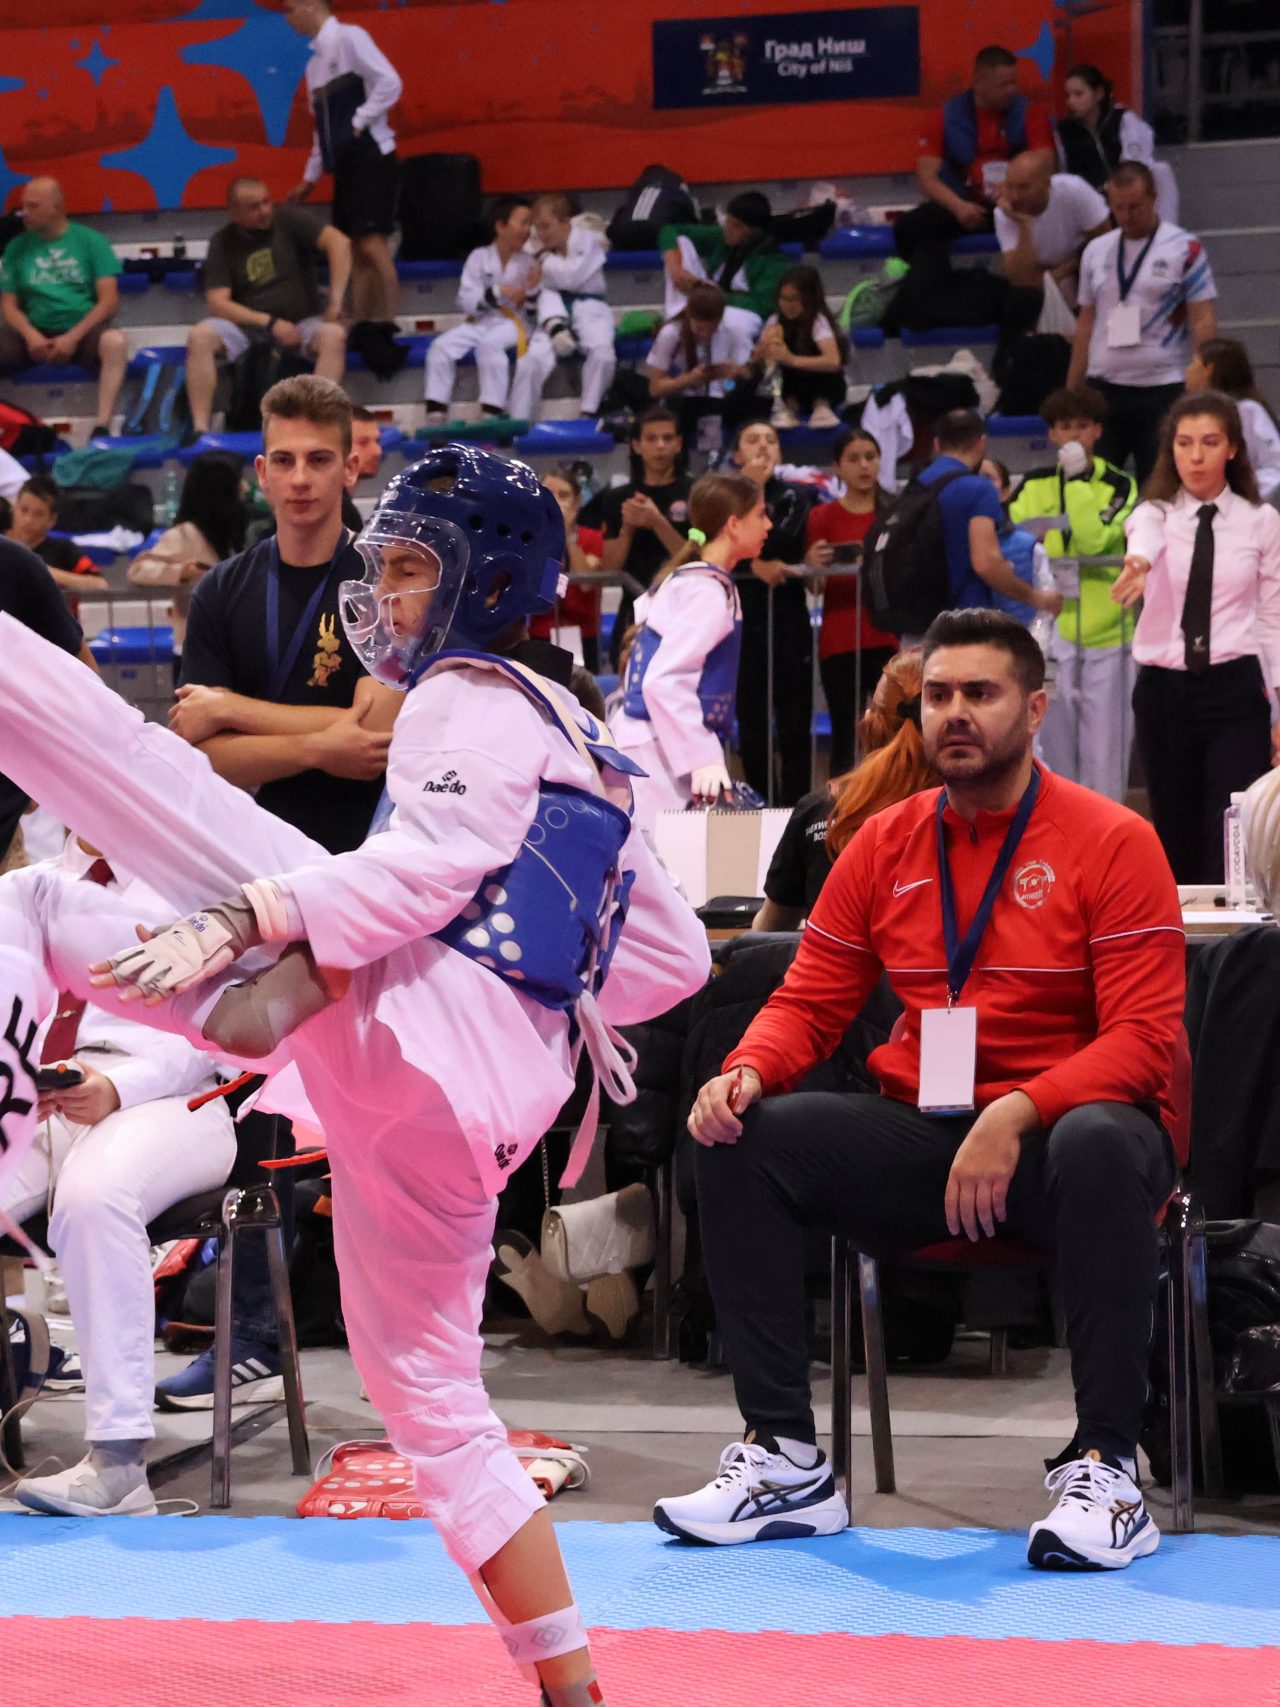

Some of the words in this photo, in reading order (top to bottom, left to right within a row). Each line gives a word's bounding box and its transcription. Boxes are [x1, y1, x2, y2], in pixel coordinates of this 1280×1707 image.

[764, 40, 814, 63] Град
[817, 37, 866, 55] Ниш
[777, 61, 808, 78] City
[810, 59, 826, 74] of
[422, 779, 467, 796] Daedo
